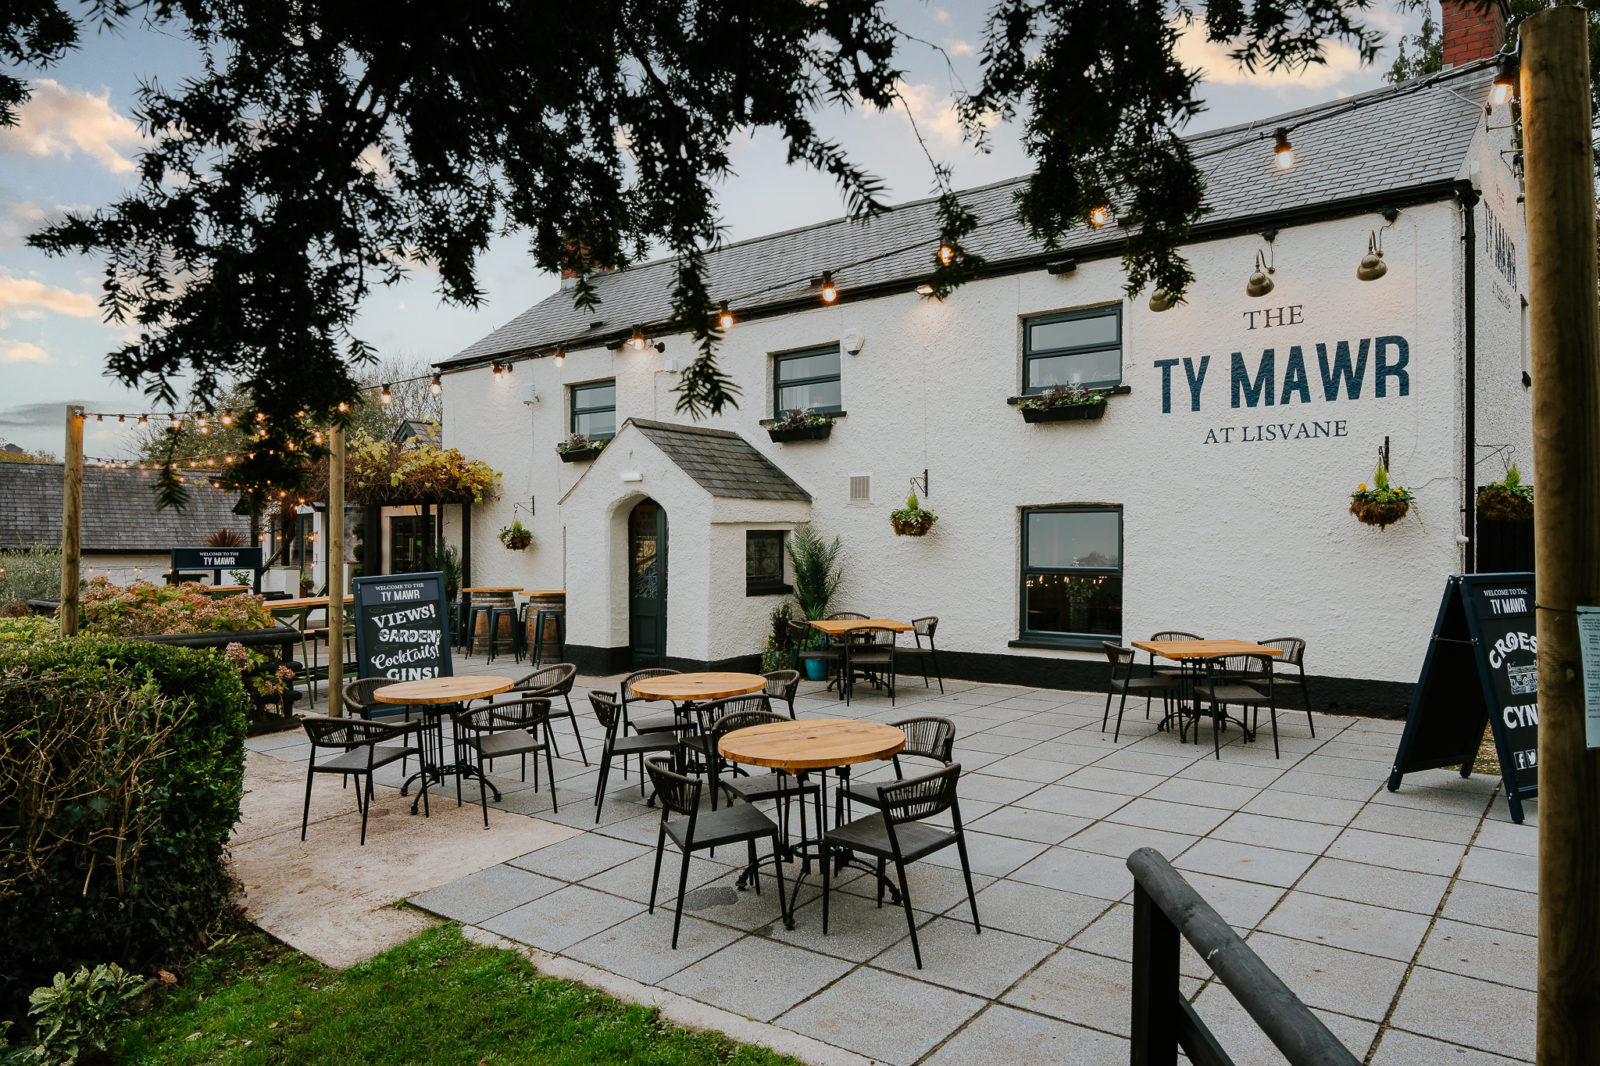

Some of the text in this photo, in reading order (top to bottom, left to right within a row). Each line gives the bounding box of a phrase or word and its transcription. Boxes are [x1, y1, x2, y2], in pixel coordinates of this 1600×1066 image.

[1243, 305, 1305, 330] THE
[1153, 335, 1410, 414] TY MAWR
[1203, 420, 1349, 444] AT LISVANE
[203, 557, 235, 566] TY MAWR
[381, 589, 421, 602] TY MAWR
[1483, 589, 1509, 597] WELCOME
[1490, 597, 1527, 615] TY MAWR
[372, 604, 436, 628] VIEWS!
[380, 629, 441, 645] GARDEN!
[371, 645, 439, 669] Cocktails!
[387, 666, 439, 680] GINS!
